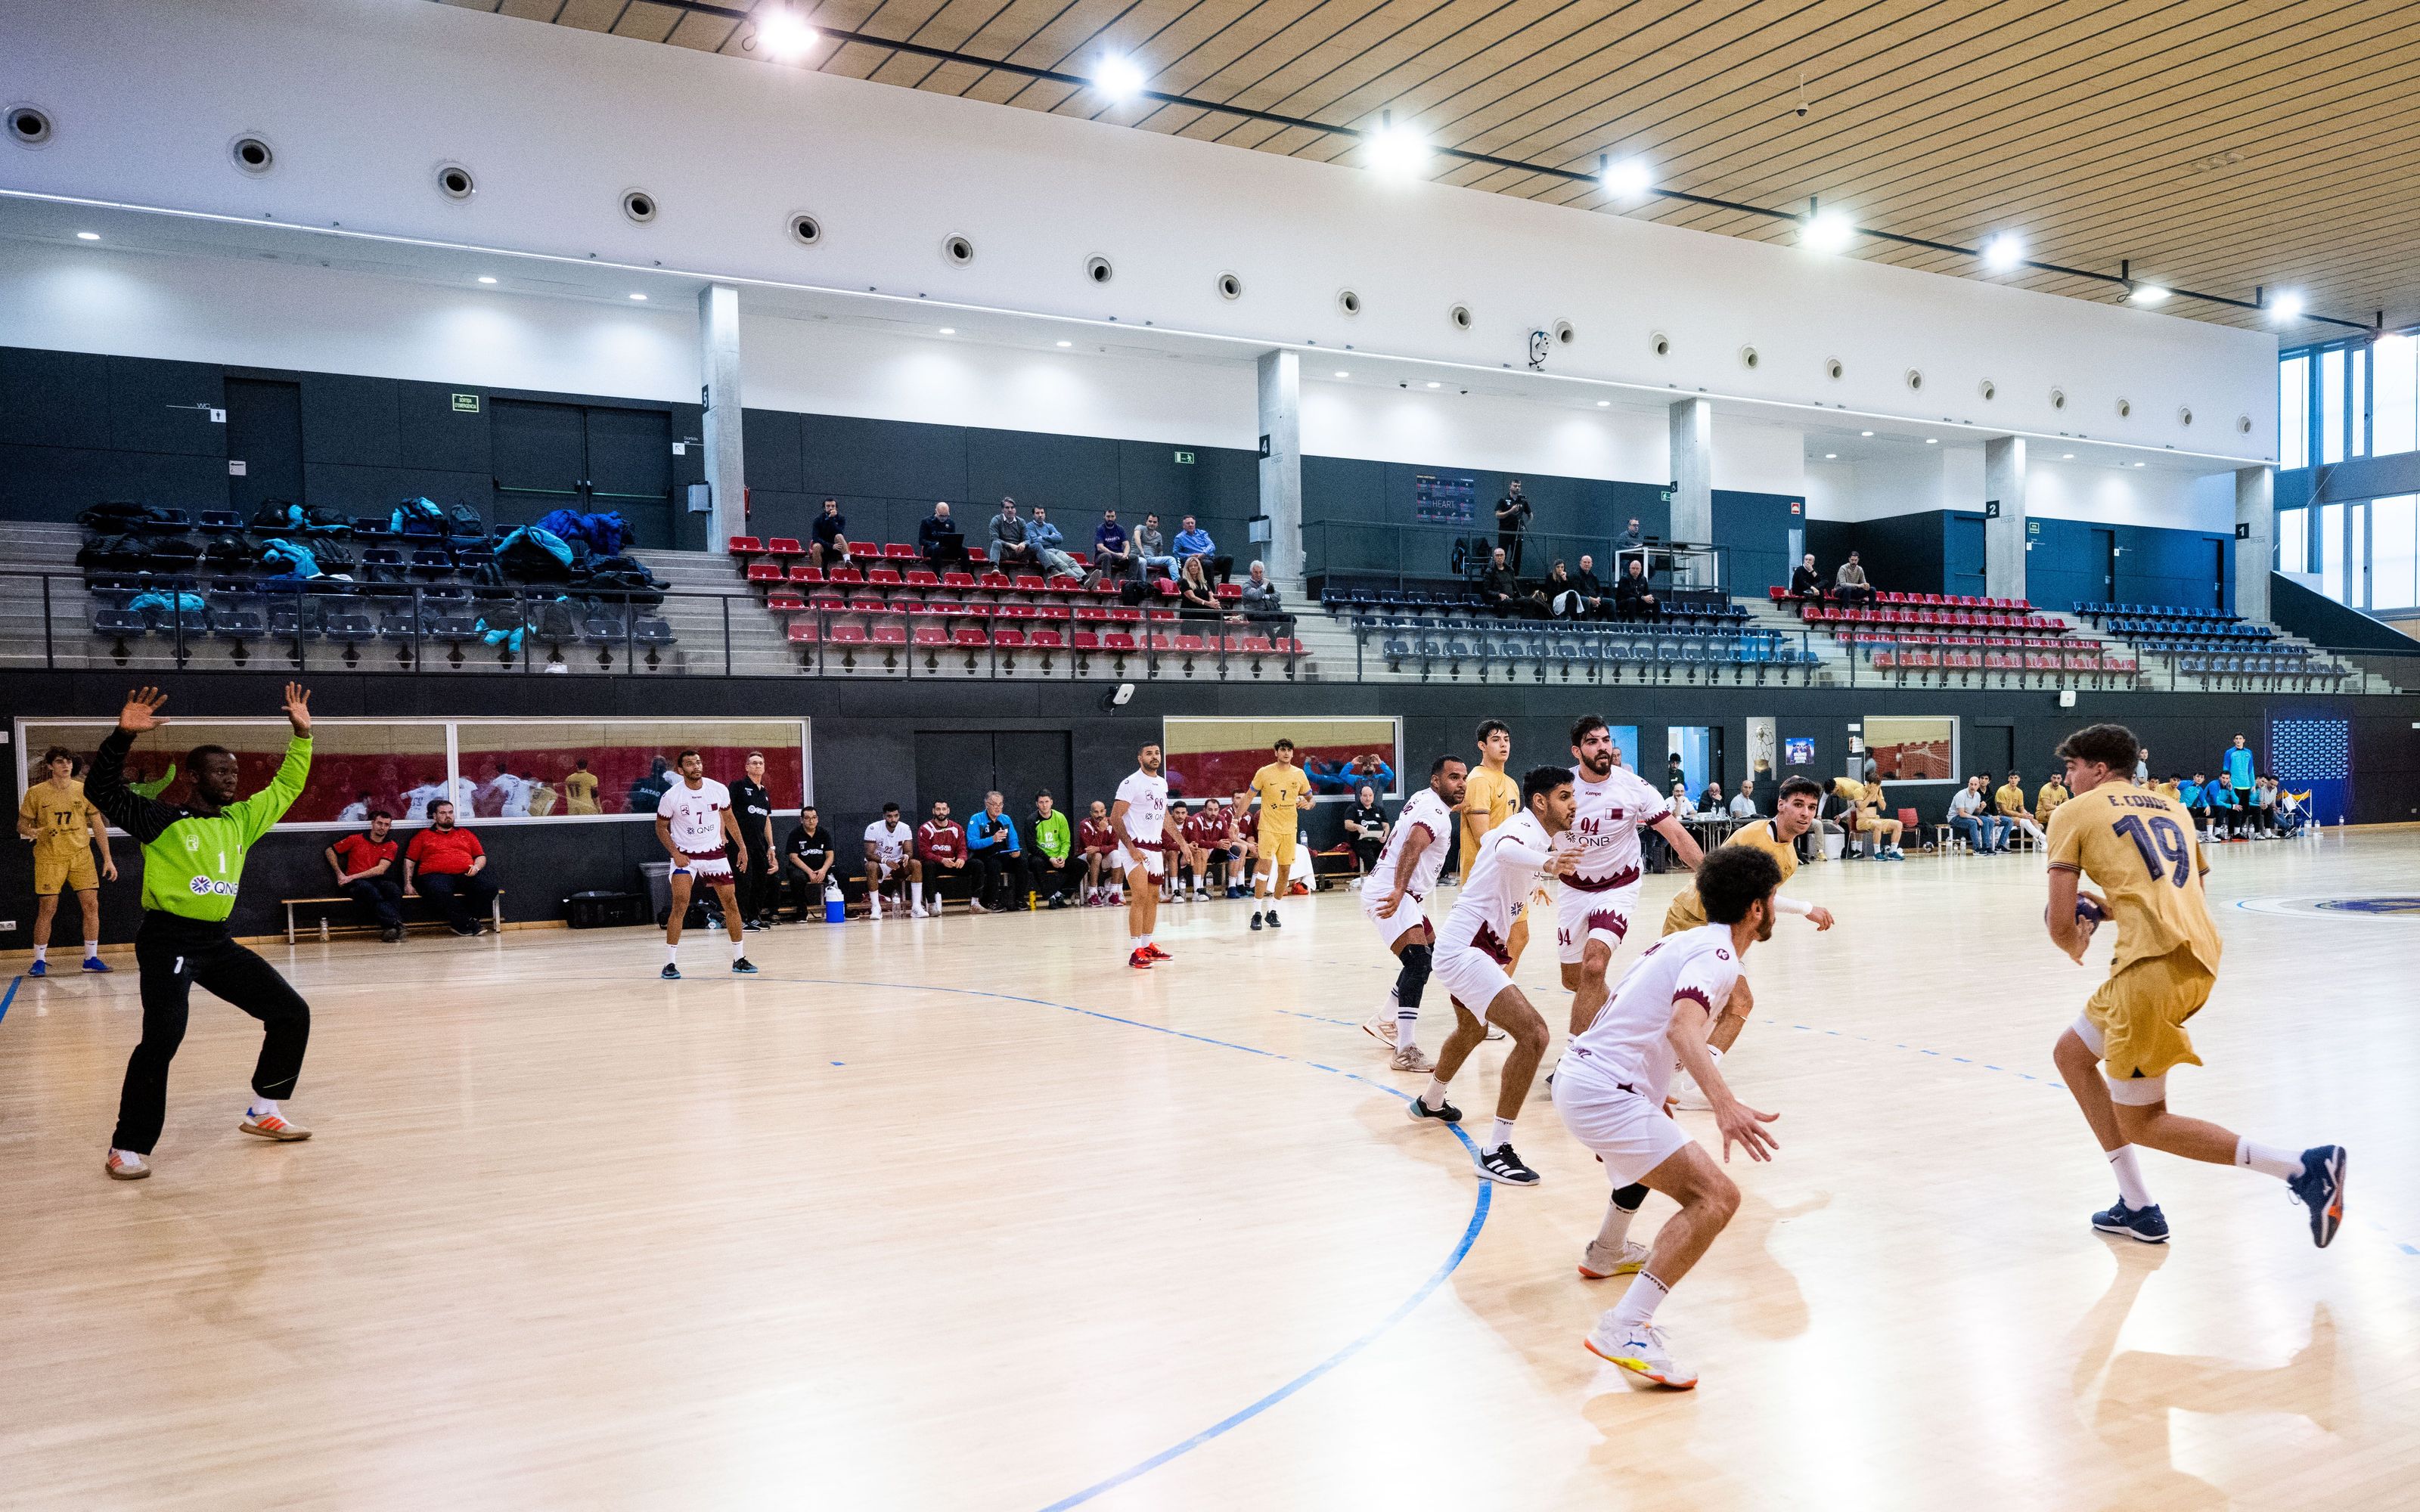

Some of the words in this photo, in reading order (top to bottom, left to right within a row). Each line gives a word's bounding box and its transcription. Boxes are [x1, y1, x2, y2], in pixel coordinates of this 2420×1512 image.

[703, 391, 709, 408] 5
[1261, 439, 1268, 454] 4
[1432, 500, 1457, 510] HEART
[1988, 503, 1996, 516] 2
[2238, 526, 2245, 537] 1
[1280, 789, 1287, 801] 7
[1153, 798, 1163, 810] 88
[54, 811, 72, 825] 77
[696, 811, 703, 825] 7
[697, 824, 715, 835] QNB
[1581, 816, 1600, 836] 94
[1044, 832, 1053, 841] 12
[1578, 836, 1611, 847] QNB
[883, 845, 894, 854] 22
[2111, 814, 2190, 889] 19
[218, 850, 227, 874] 1
[1557, 927, 1572, 947] 94
[173, 956, 185, 974] 1
